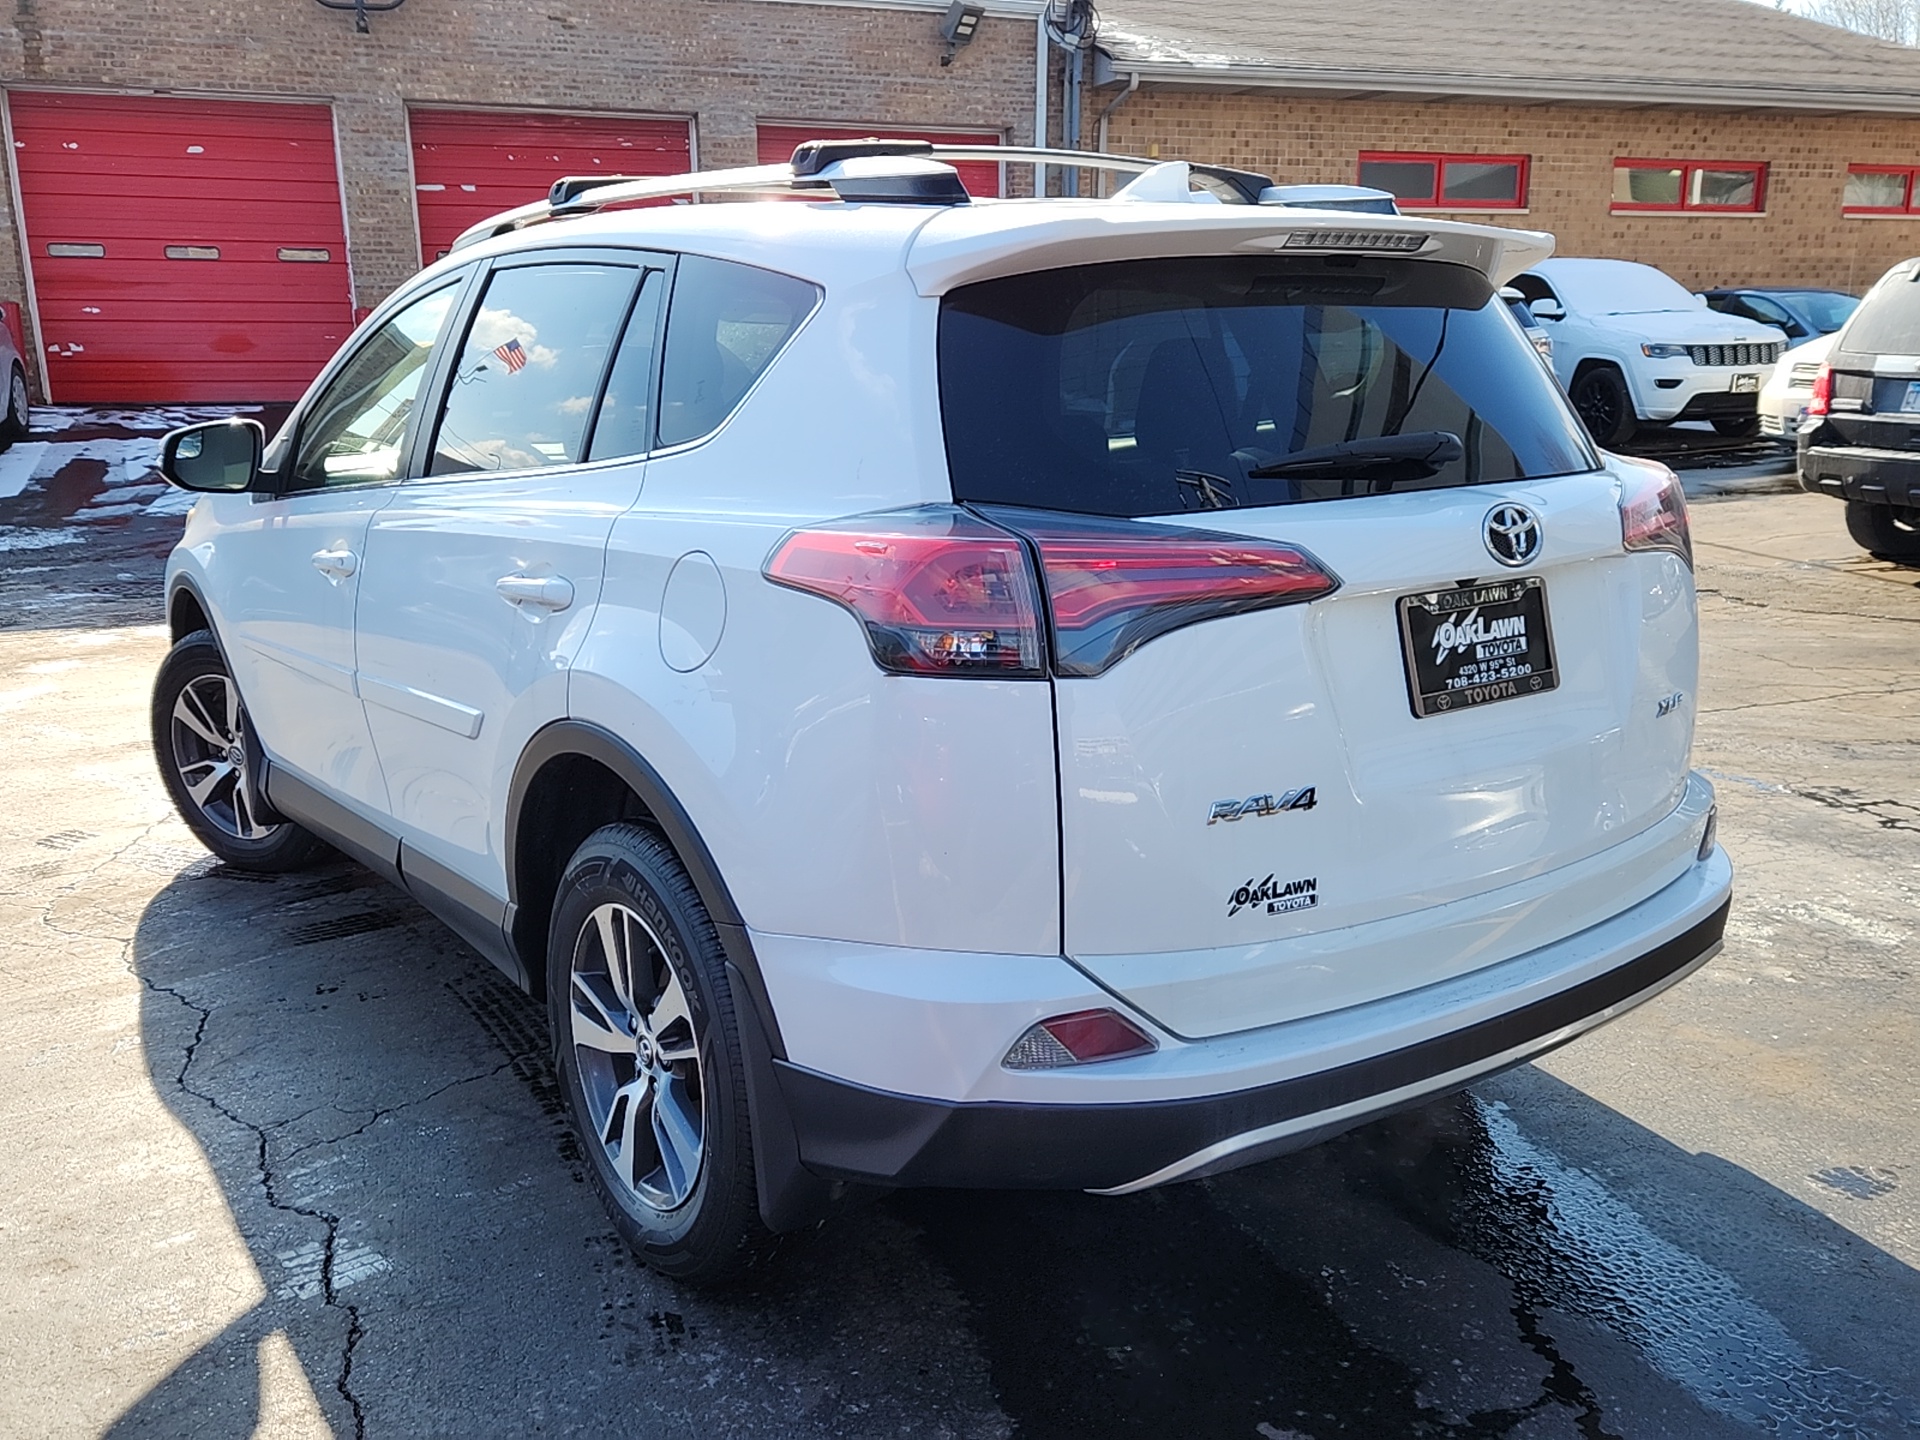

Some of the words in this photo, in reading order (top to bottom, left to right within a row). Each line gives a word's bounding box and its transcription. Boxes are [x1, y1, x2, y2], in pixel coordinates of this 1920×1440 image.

[1443, 593, 1471, 609] OAK
[1473, 586, 1508, 604] LAWN
[1481, 638, 1522, 657] TOYOTA
[1445, 663, 1532, 690] 708-423-5200
[1459, 663, 1478, 676] 4320
[1479, 661, 1488, 672] W
[1464, 681, 1517, 704] TOYOTA
[1207, 785, 1318, 825] RAV4
[1273, 896, 1312, 912] TOYOTA
